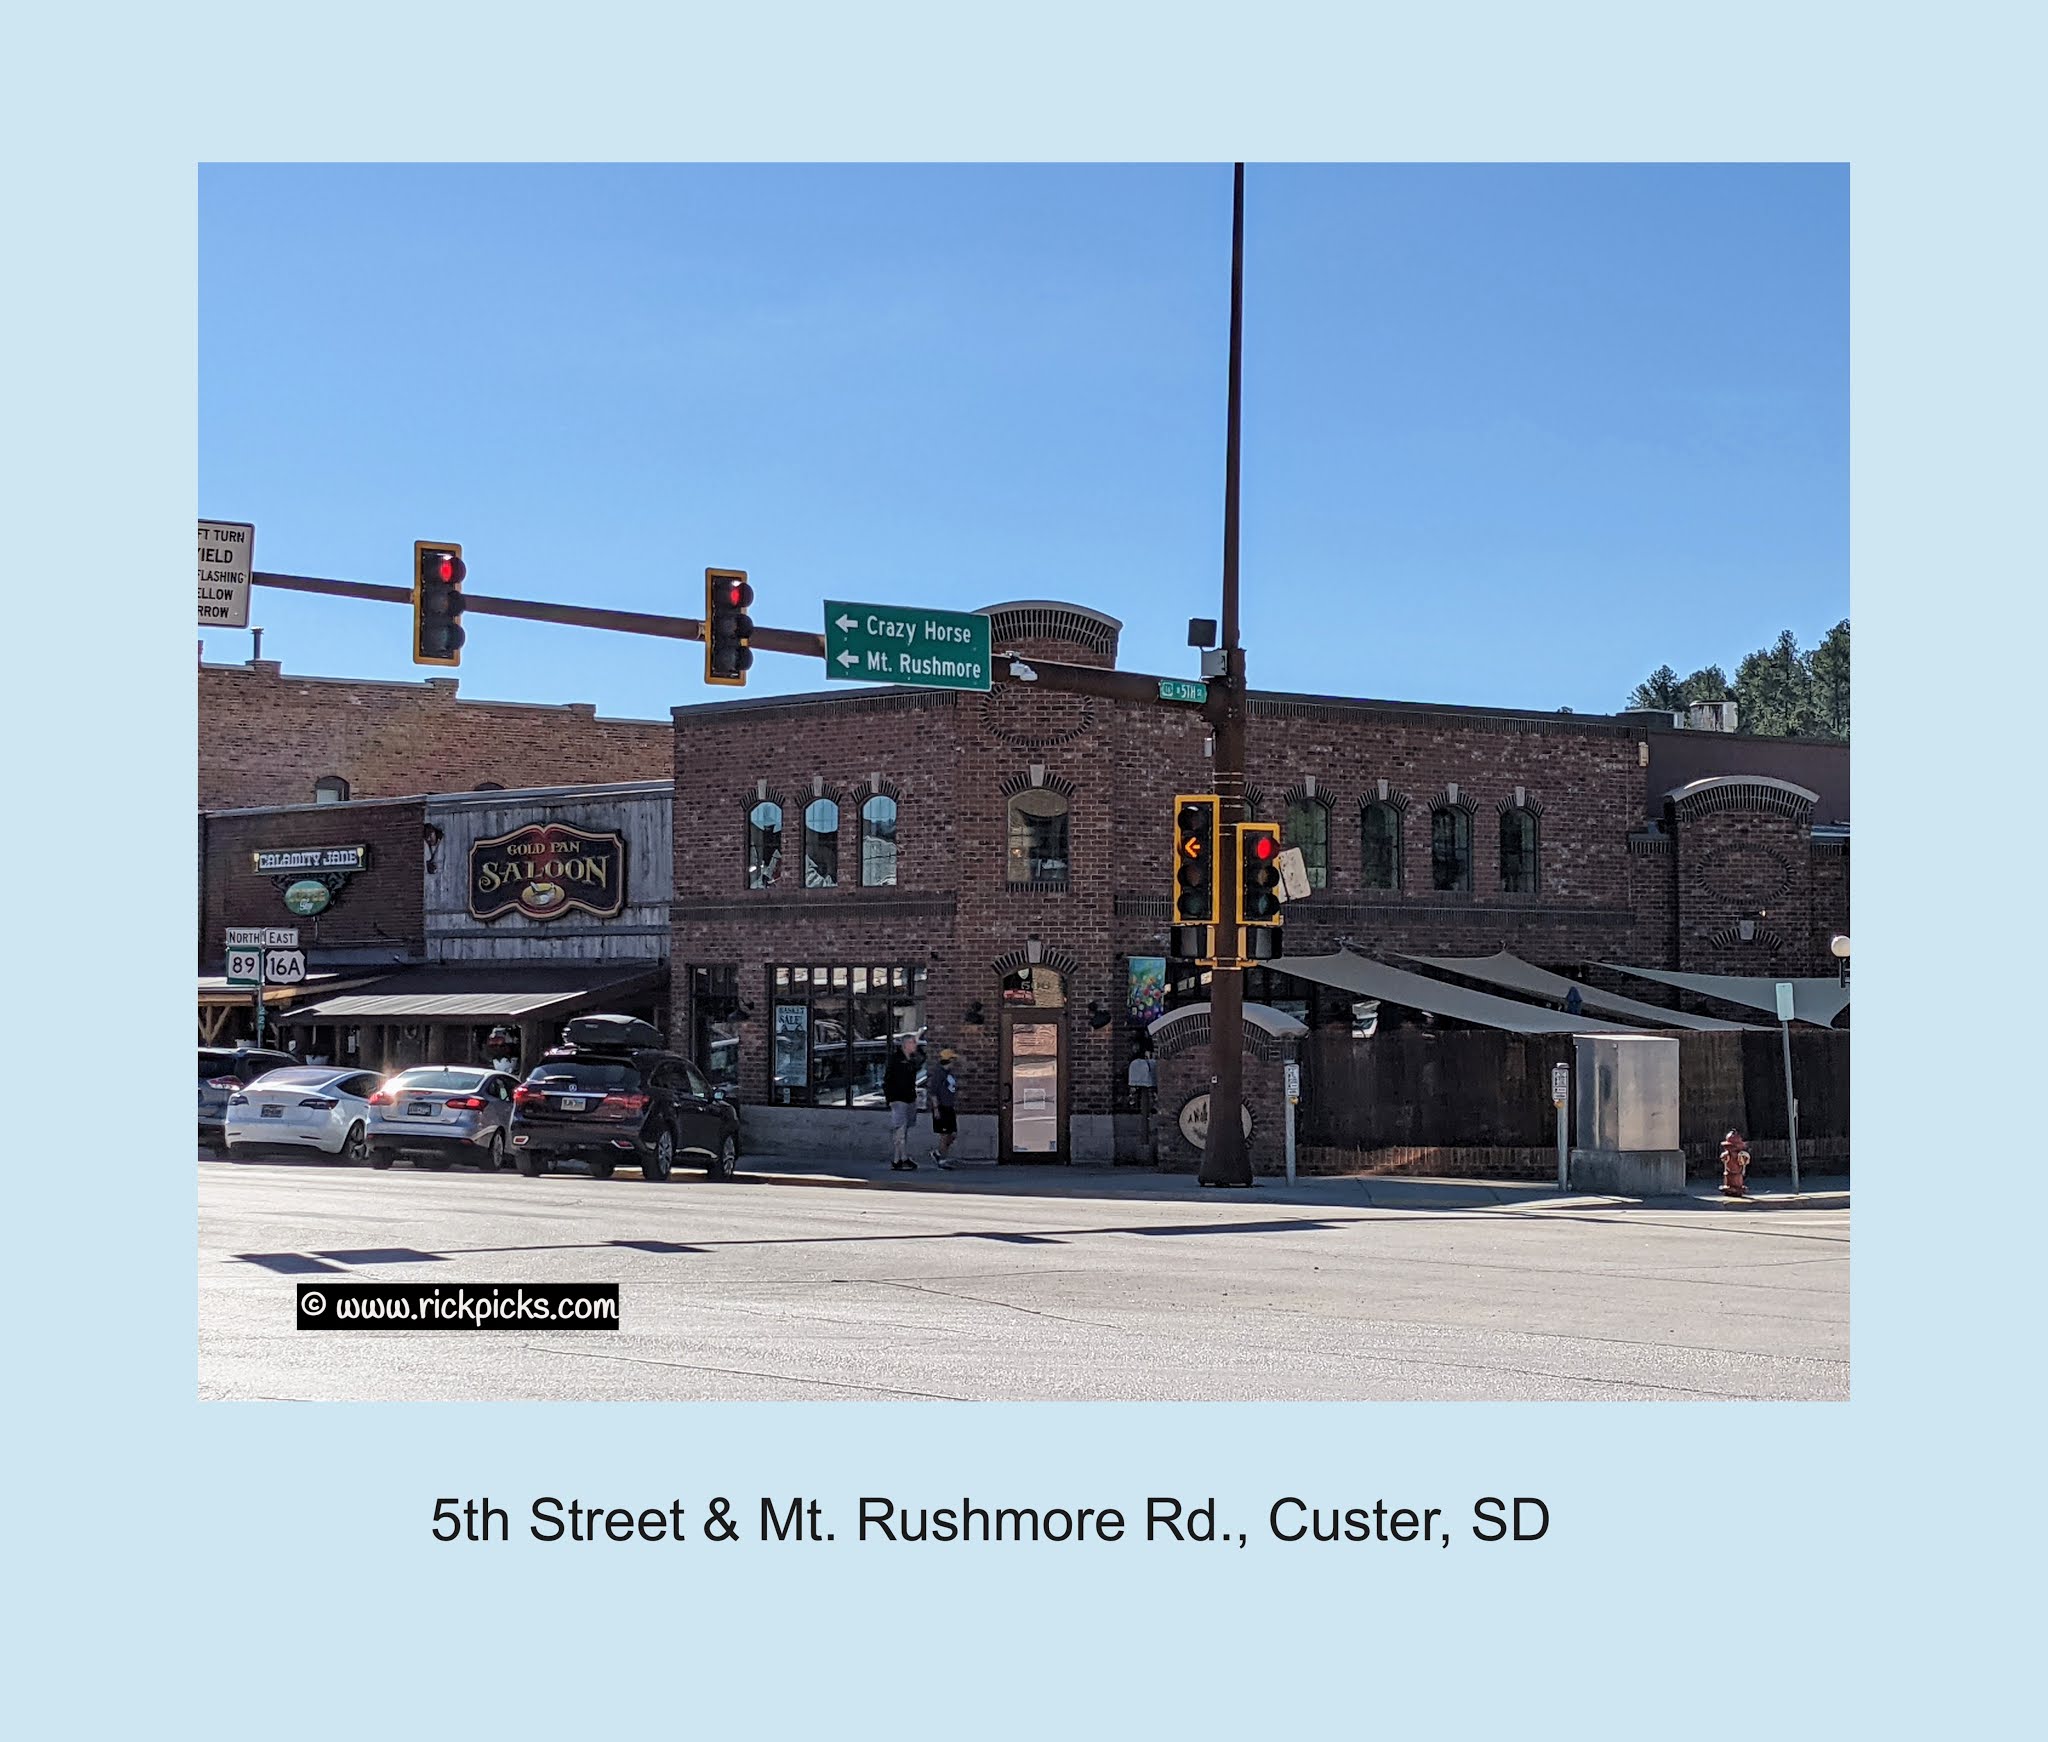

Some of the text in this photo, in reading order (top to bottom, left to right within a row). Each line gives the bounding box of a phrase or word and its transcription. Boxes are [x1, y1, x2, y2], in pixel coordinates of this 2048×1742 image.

[214, 530, 245, 543] TURN
[866, 615, 972, 646] Crazy Horse
[867, 650, 981, 679] Mt. Rushmore
[1180, 684, 1196, 699] 5TH
[506, 840, 582, 856] GOLD PAN
[259, 849, 358, 868] CALAMITY JANE
[478, 854, 611, 893] SALOON
[229, 931, 260, 944] NORTH
[269, 931, 294, 944] EAST
[232, 956, 255, 974] 89
[270, 957, 301, 976] 16A
